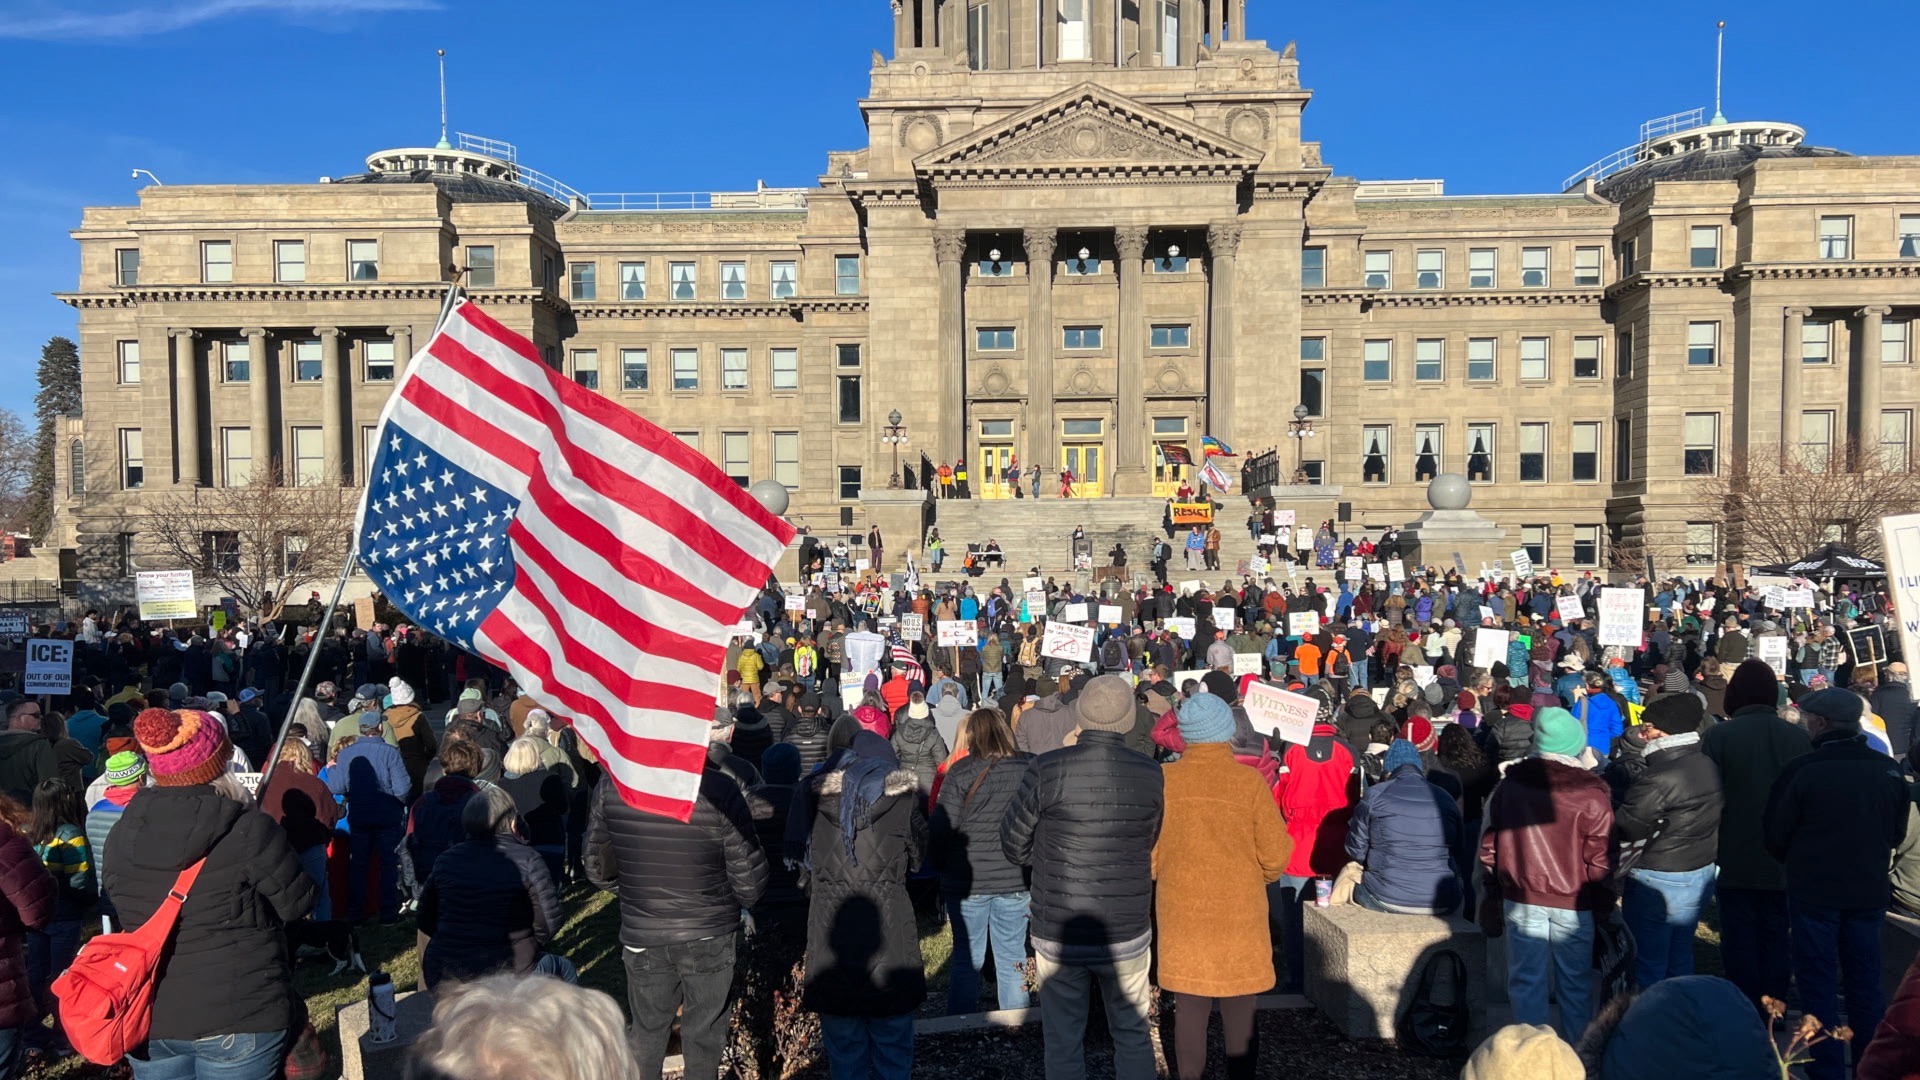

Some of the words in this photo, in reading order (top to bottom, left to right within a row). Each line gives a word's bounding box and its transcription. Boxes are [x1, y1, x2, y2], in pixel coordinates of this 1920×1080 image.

[1173, 507, 1210, 518] RESIST
[31, 644, 68, 662] ICE:
[1053, 640, 1076, 653] ICE
[54, 673, 70, 681] OUR
[1252, 692, 1309, 719] WITNESS
[1264, 710, 1279, 720] FOR
[1281, 715, 1304, 727] GOOD
